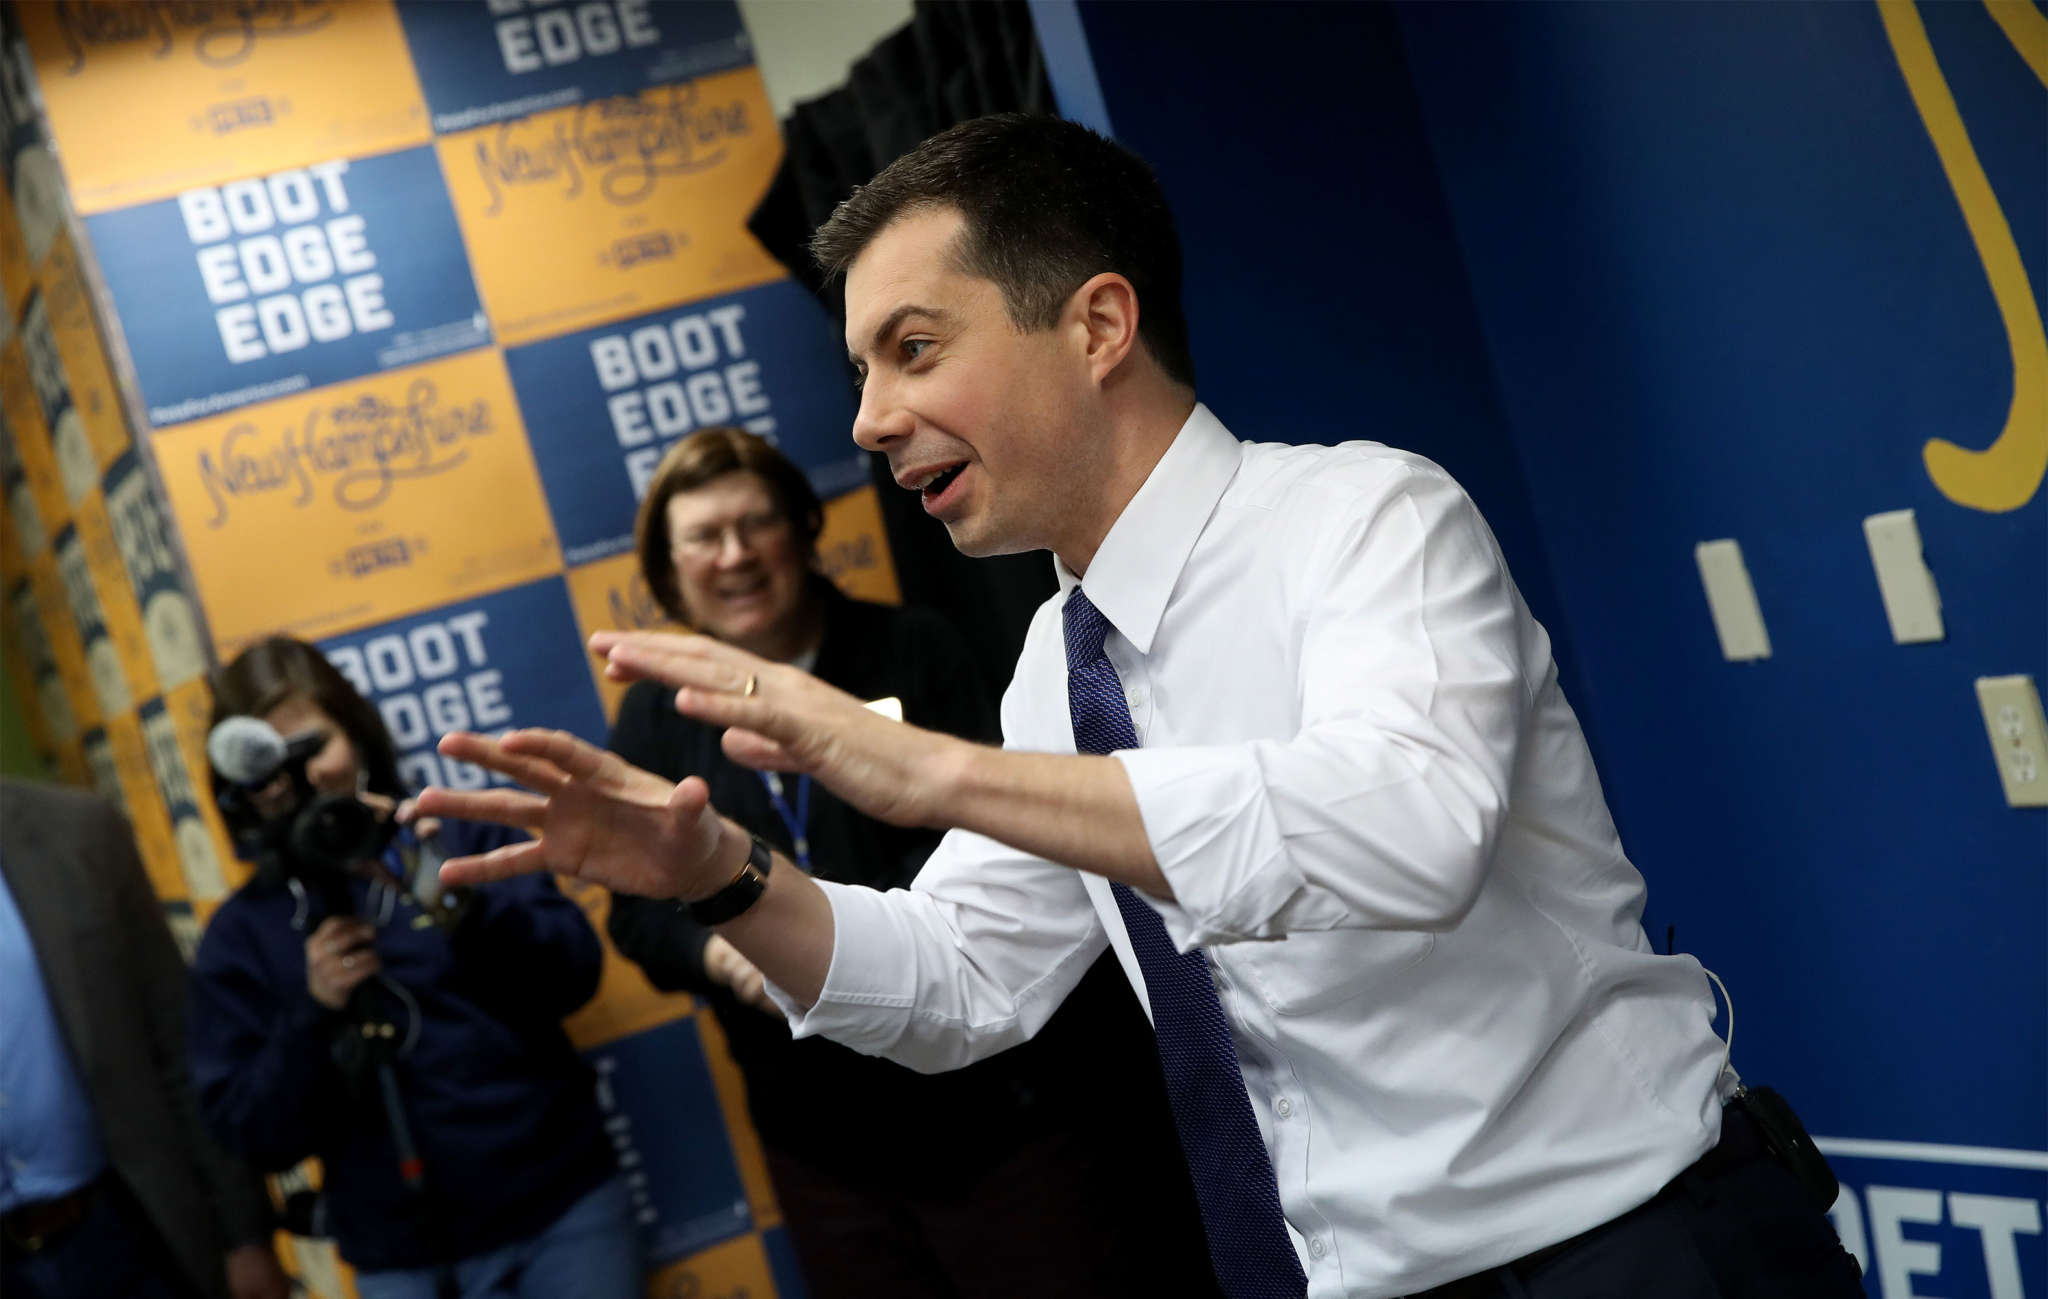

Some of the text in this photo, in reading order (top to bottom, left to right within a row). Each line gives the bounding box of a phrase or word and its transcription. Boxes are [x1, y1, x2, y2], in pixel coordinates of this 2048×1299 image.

[494, 0, 661, 75] EDGE
[177, 160, 350, 245] BOOT
[196, 214, 377, 304] EDGE
[215, 273, 395, 364] EDGE
[590, 304, 746, 392] BOOT
[607, 361, 771, 448] EDGE
[378, 669, 513, 748] DGE
[1824, 1182, 2048, 1299] ET
